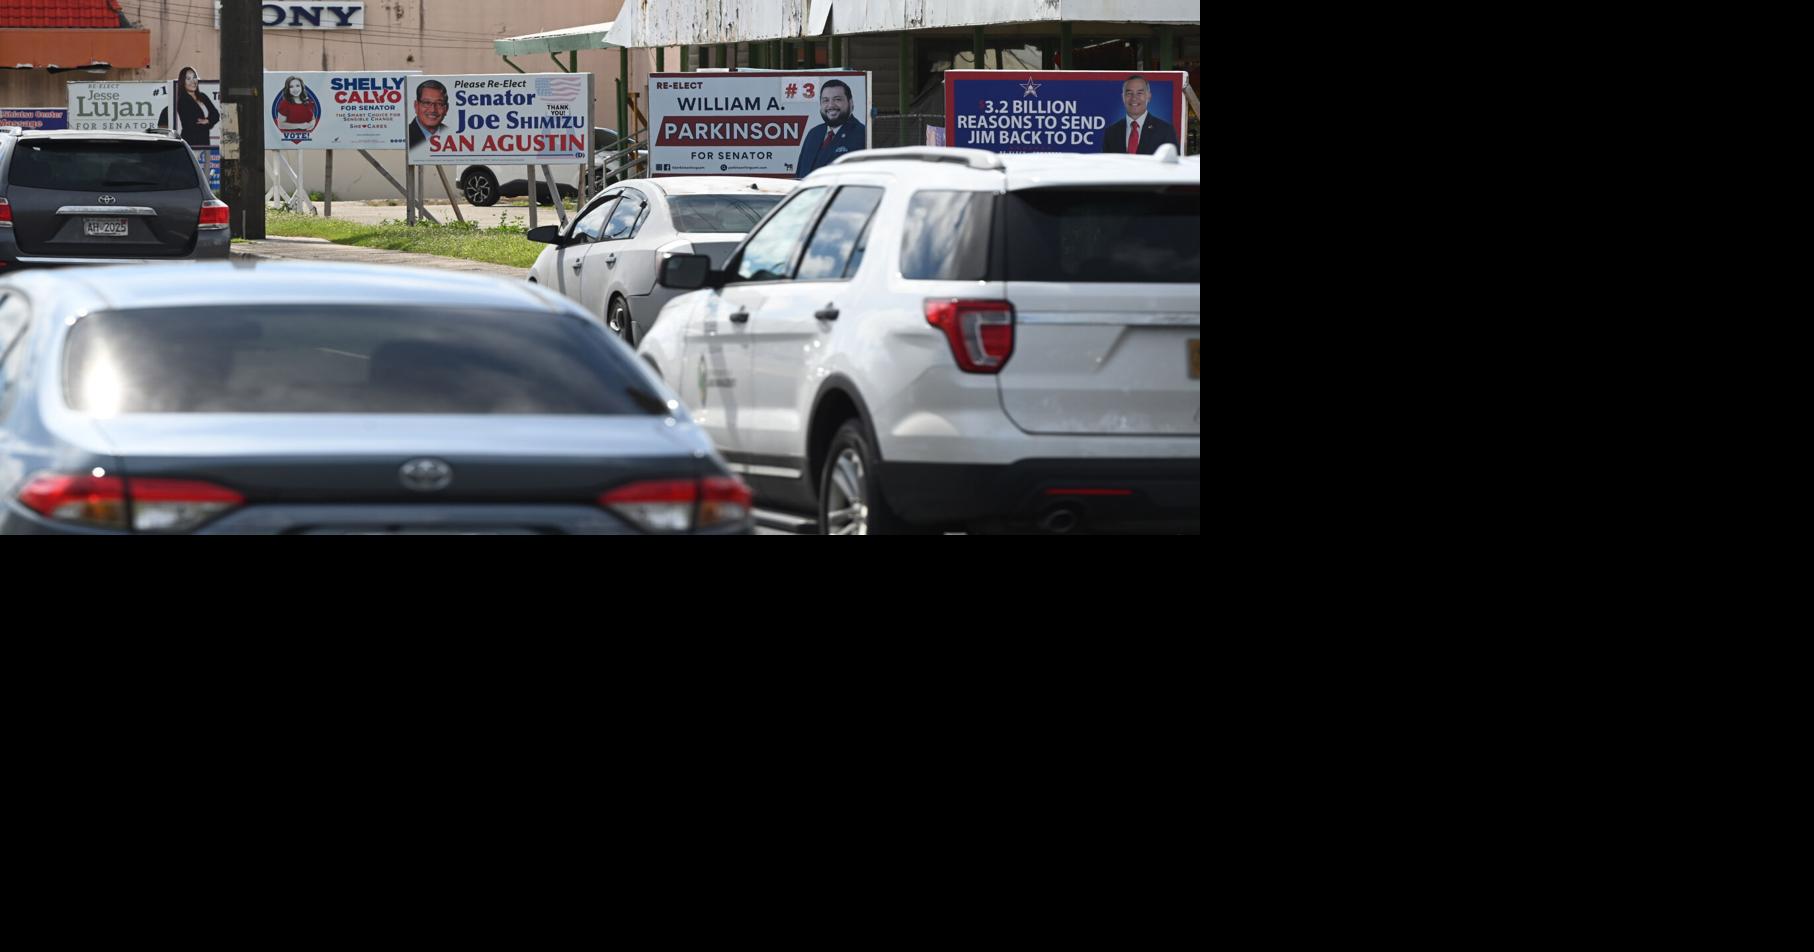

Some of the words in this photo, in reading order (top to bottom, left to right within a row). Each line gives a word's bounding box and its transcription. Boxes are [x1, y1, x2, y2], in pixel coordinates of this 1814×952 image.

[262, 5, 362, 27] ONY
[331, 77, 405, 90] SHELLY
[454, 80, 484, 89] Please
[487, 79, 527, 88] Re-Elect
[656, 82, 703, 90] RE-ELECT
[88, 90, 120, 101] Jesse
[152, 86, 168, 97] #1
[334, 88, 402, 104] CALVO
[455, 90, 536, 107] Senator
[76, 96, 154, 122] Lujan
[677, 97, 762, 111] WILLIAM
[766, 97, 786, 111] A.
[1012, 100, 1077, 114] BILLION
[102, 122, 156, 130] SENATOR
[455, 109, 500, 134] Joe
[957, 115, 1033, 129] REASONS
[1035, 115, 1057, 129] TO
[1061, 115, 1106, 130] SEND
[283, 132, 311, 140] VOTE!
[664, 122, 799, 140] PARKINSON
[967, 130, 995, 144] JIM
[999, 130, 1043, 145] BACK
[1045, 130, 1067, 145] TO
[1070, 131, 1094, 145] DC
[429, 134, 475, 152] SAN
[482, 134, 585, 152] AGUSTIN
[690, 151, 714, 160] FOR
[718, 151, 774, 160] SENATOR
